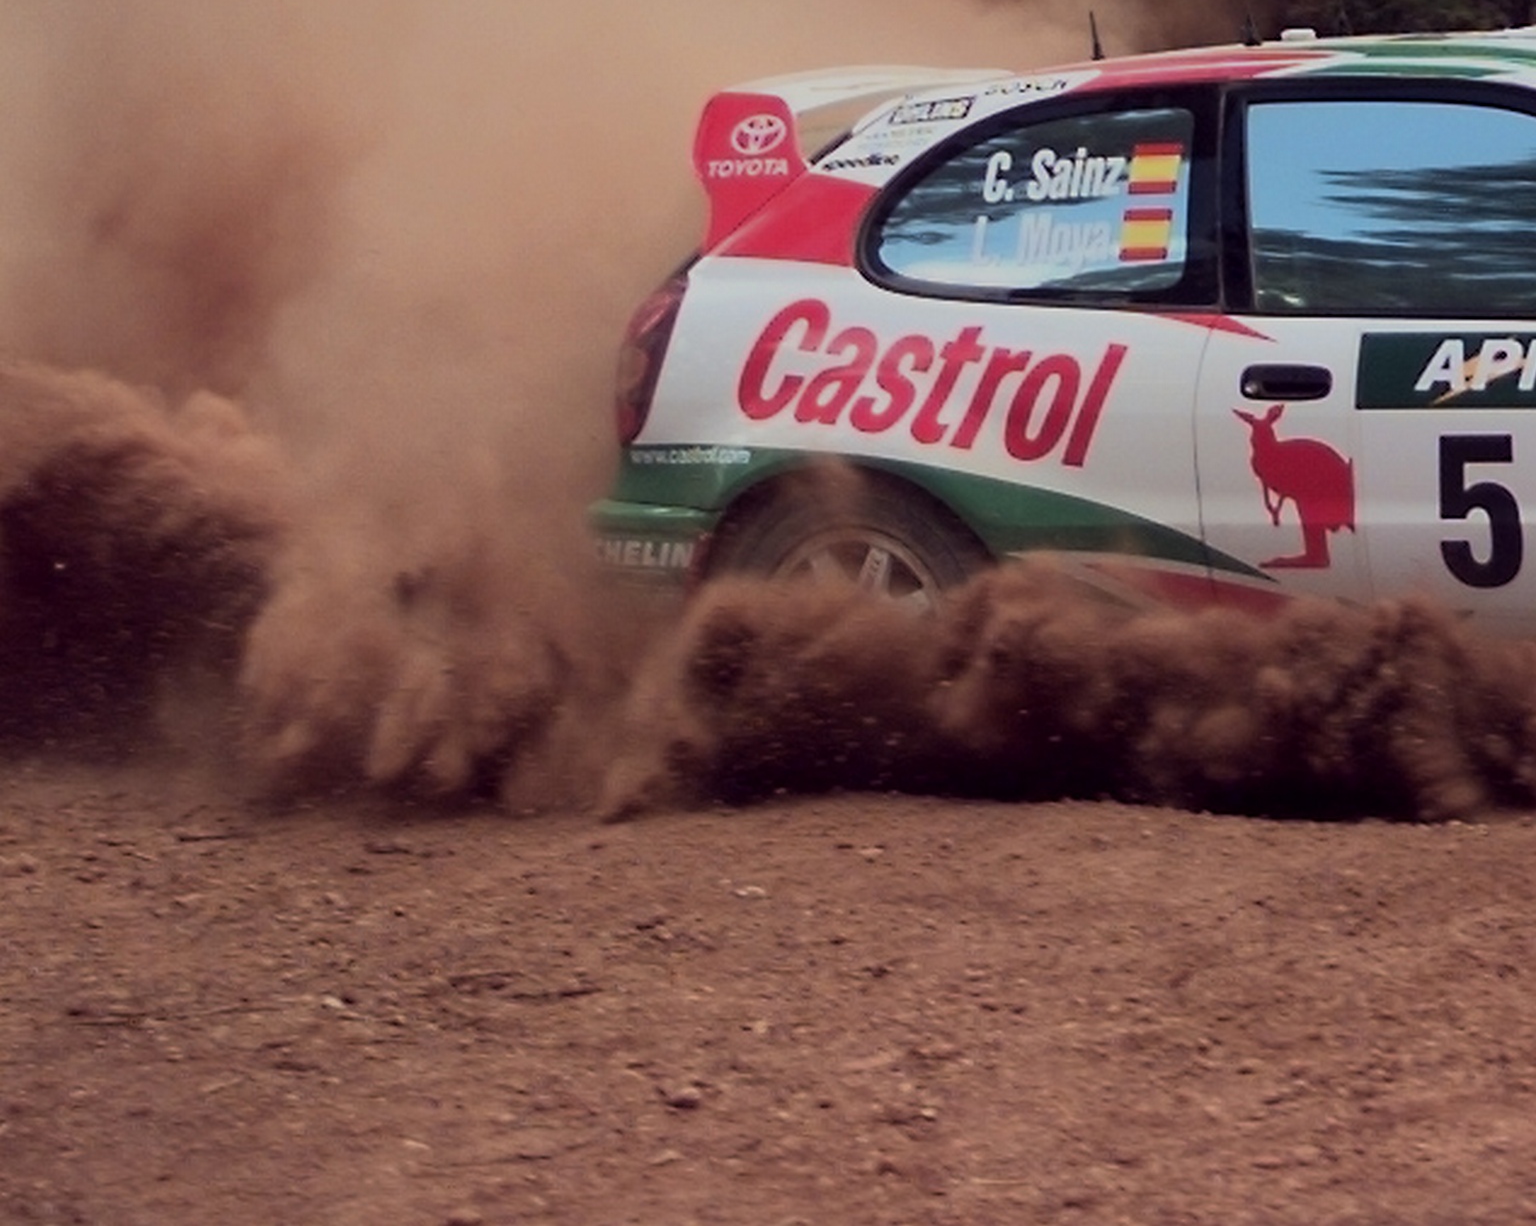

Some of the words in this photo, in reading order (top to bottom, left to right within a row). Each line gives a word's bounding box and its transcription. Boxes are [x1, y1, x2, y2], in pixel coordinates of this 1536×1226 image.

[706, 159, 789, 178] TOYOTA
[983, 151, 1014, 203] C.
[1026, 146, 1126, 201] Sainz
[1017, 212, 1112, 270] Moya
[736, 297, 1129, 469] Castrol
[1439, 434, 1524, 588] 5
[592, 539, 695, 569] HELIN
